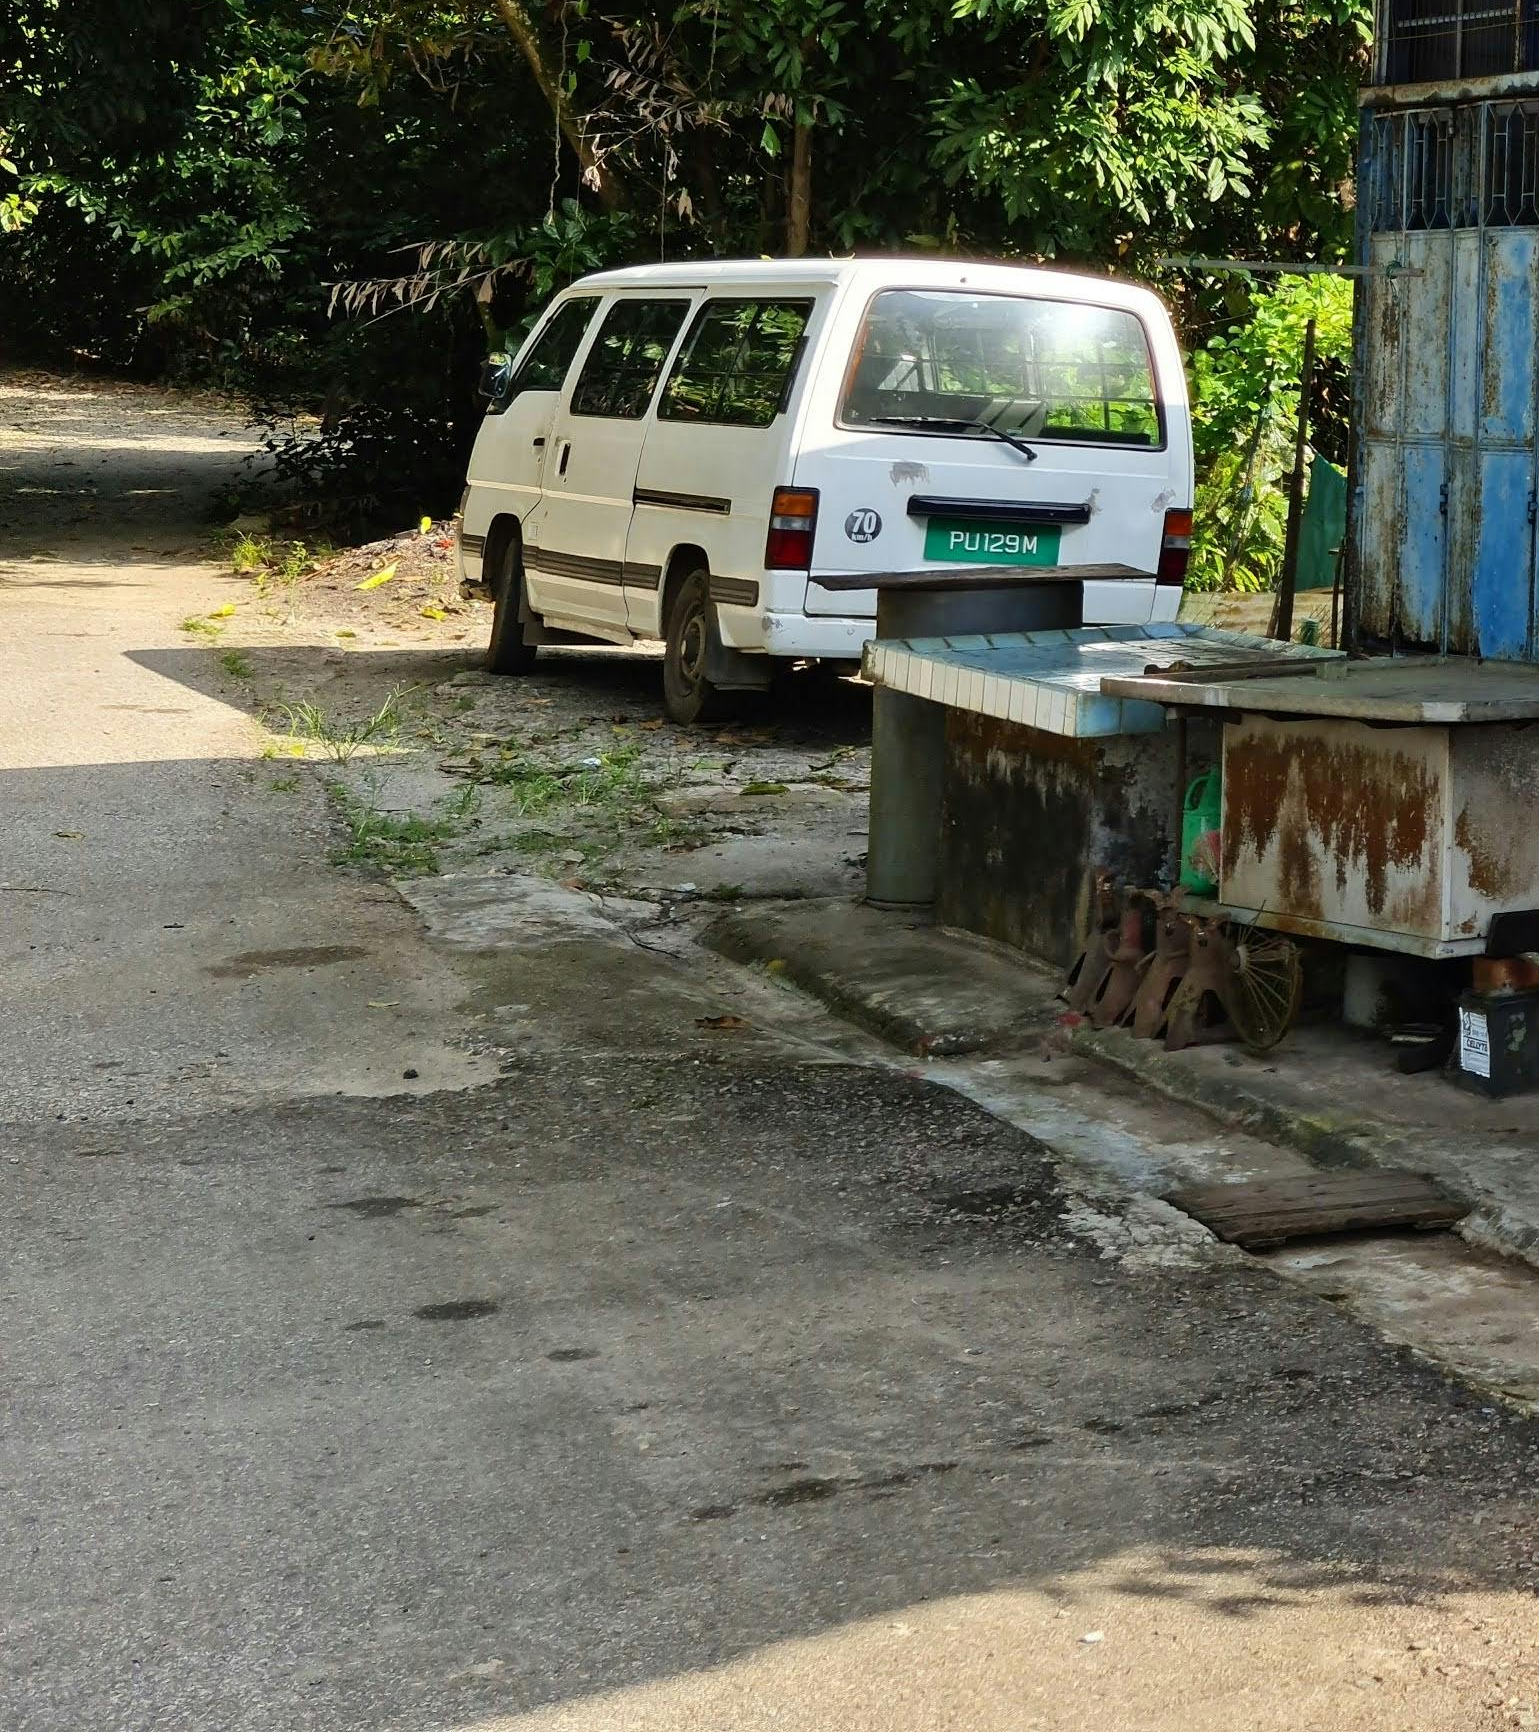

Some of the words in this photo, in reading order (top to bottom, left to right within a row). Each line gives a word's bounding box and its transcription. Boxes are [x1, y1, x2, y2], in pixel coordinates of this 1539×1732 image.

[852, 510, 878, 534] 70
[851, 533, 873, 542] km/h
[948, 530, 1038, 555] PU129M
